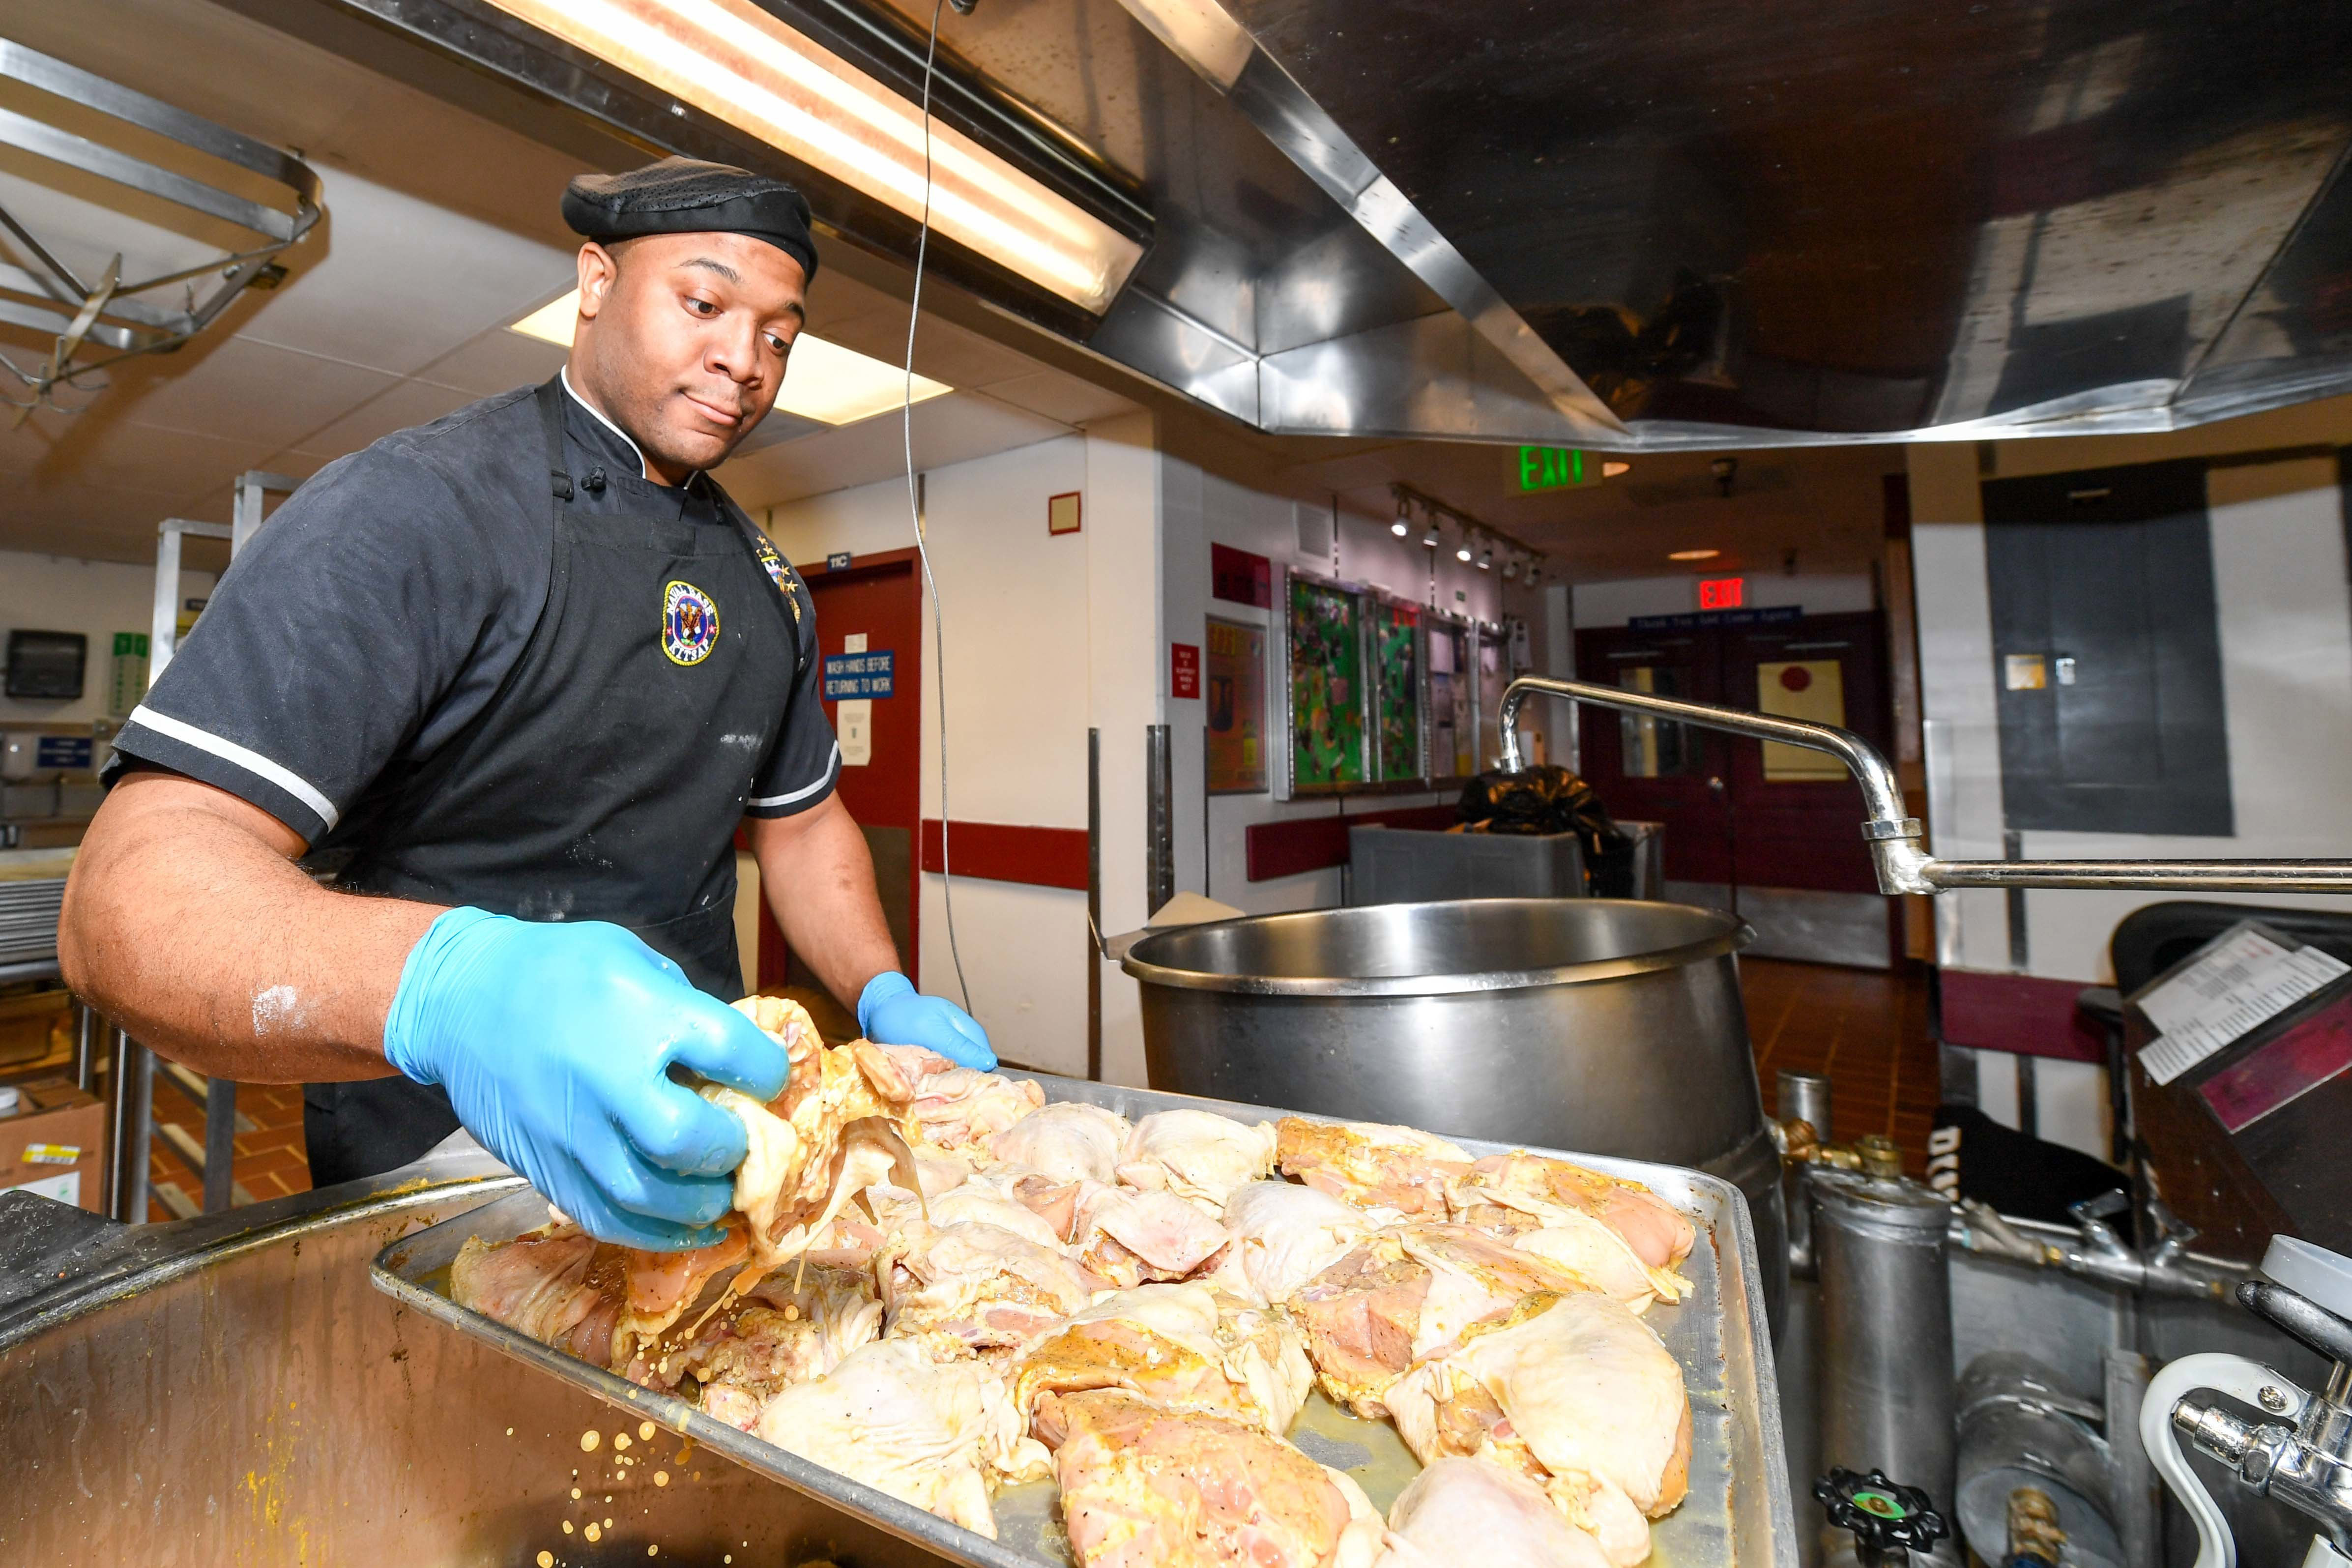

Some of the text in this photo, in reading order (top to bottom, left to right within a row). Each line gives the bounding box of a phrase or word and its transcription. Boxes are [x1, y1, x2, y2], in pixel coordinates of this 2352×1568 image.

[1519, 445, 1583, 490] EXIT
[667, 583, 713, 616] NAVAL BASE
[1699, 578, 1744, 610] EXIT
[668, 639, 709, 661] KITSAP
[867, 655, 891, 672] BEFORE
[826, 677, 891, 695] RETURNING TO WORK
